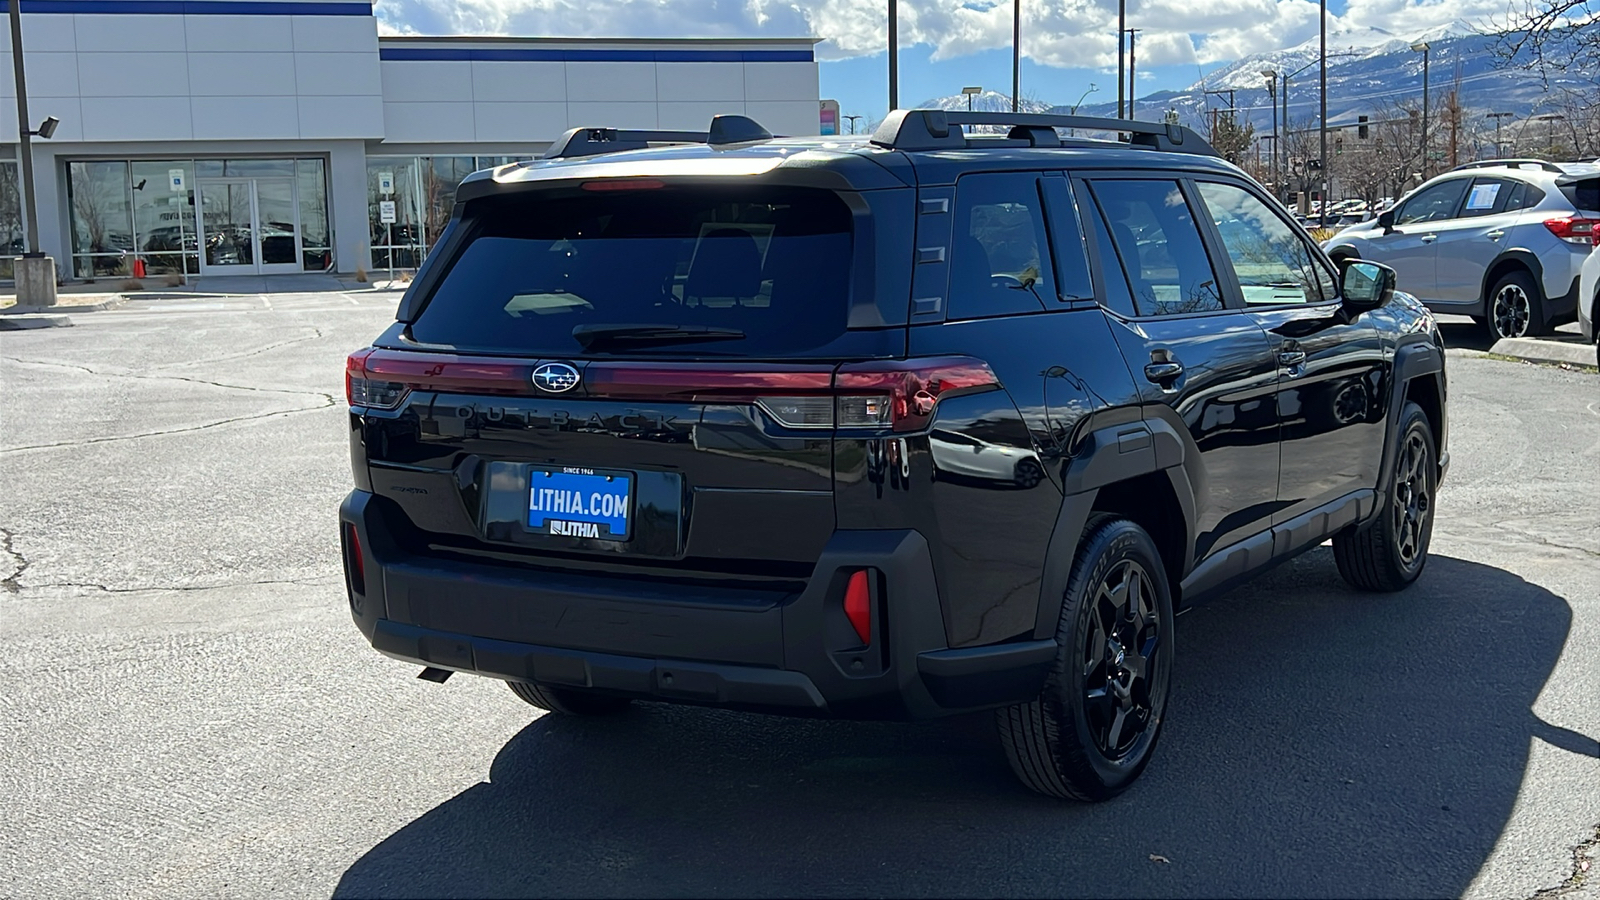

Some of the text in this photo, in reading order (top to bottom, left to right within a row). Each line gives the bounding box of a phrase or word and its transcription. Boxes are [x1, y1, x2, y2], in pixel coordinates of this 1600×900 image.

[456, 405, 678, 431] OUTBACK
[563, 466, 594, 476] SINCE 1946
[530, 488, 628, 519] LITHIA.COM
[561, 521, 598, 538] LITHIA
